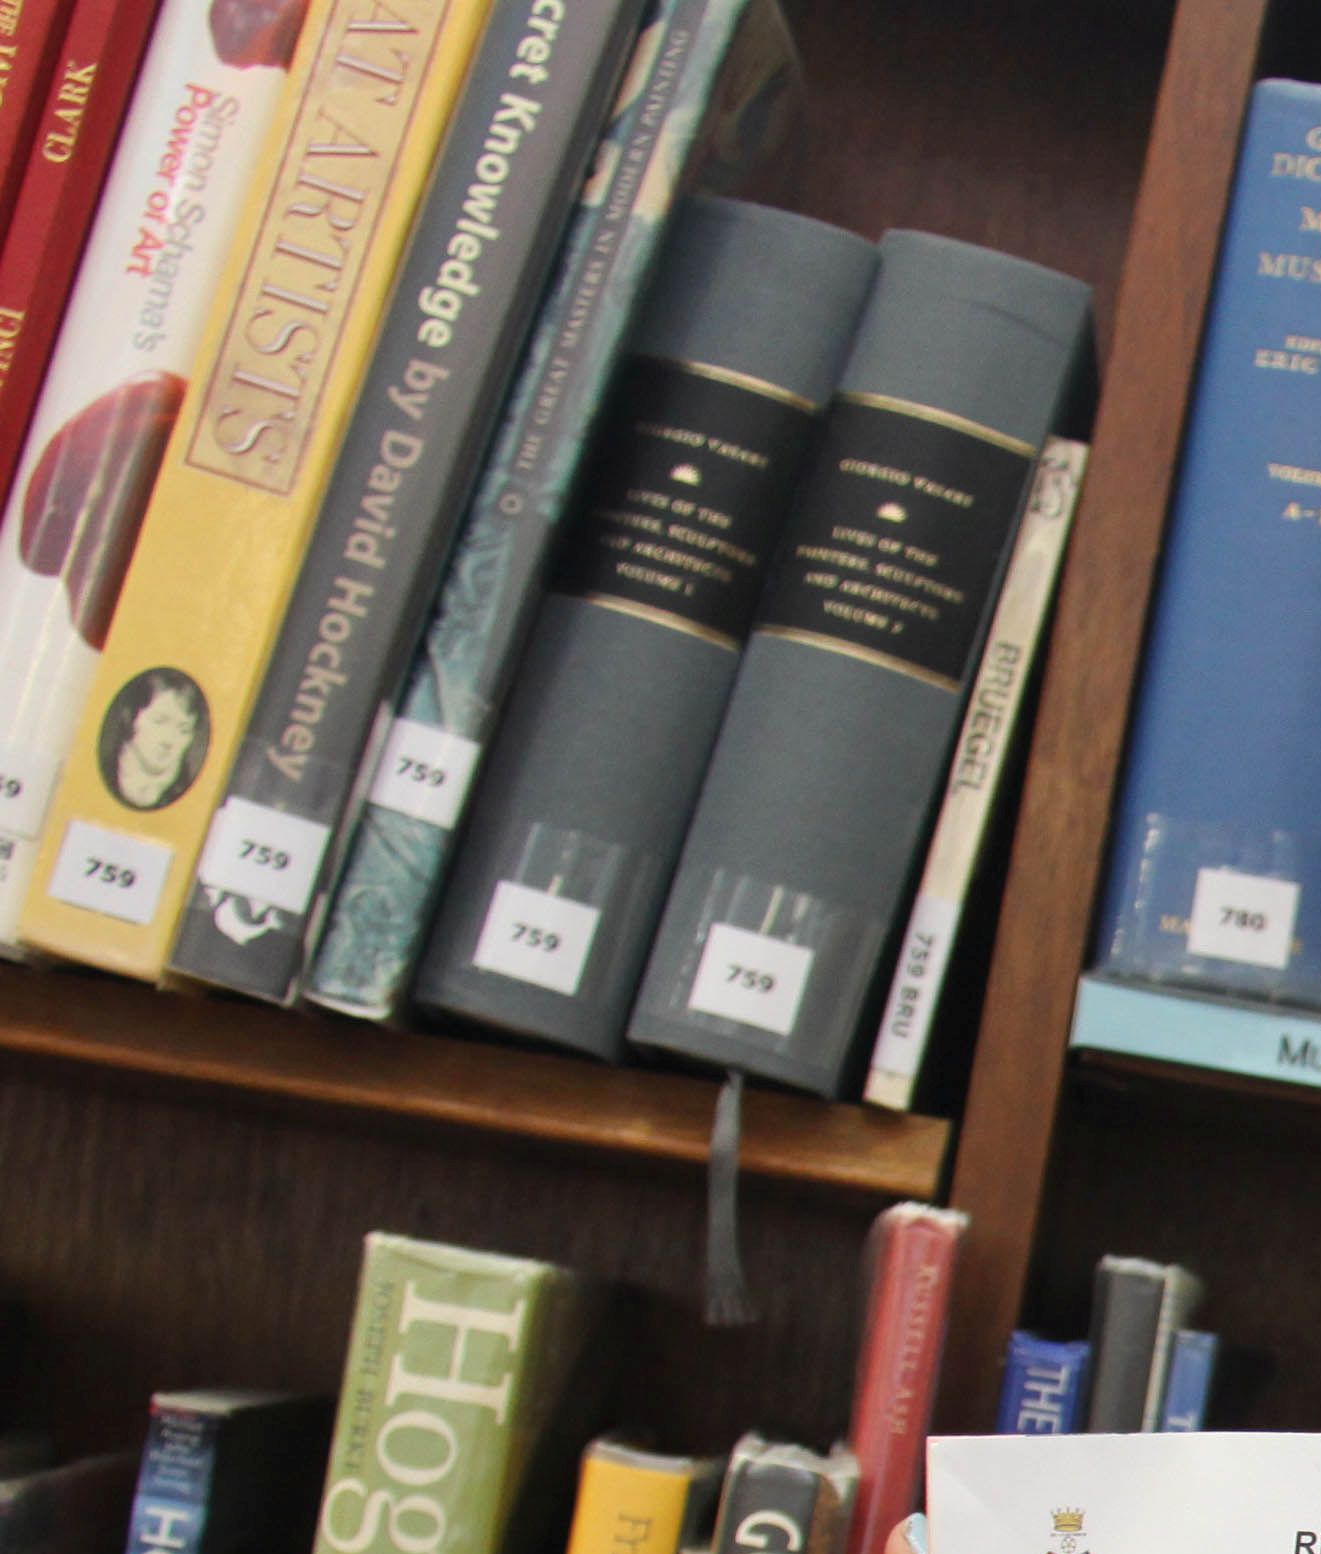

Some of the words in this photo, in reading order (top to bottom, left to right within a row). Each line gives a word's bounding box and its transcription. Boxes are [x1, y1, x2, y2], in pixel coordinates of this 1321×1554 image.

[43, 61, 98, 163] CLARK
[156, 83, 212, 180] Power
[185, 94, 239, 191] Simon
[144, 191, 170, 224] of
[419, 94, 542, 349] Knowledge
[126, 228, 164, 277] Art
[216, 110, 379, 464] ARTISTS
[389, 359, 449, 419] by
[345, 429, 423, 568] David
[267, 576, 374, 782] Hockney
[952, 640, 1021, 793] BRUEGEL
[396, 758, 445, 788] 759
[83, 858, 136, 888] 759
[238, 841, 292, 870] 759
[510, 923, 561, 953] 759
[1219, 908, 1268, 932] 780
[724, 963, 776, 994] 759
[909, 932, 933, 978] 759
[892, 986, 920, 1039] BRU
[1017, 1364, 1069, 1433] THE
